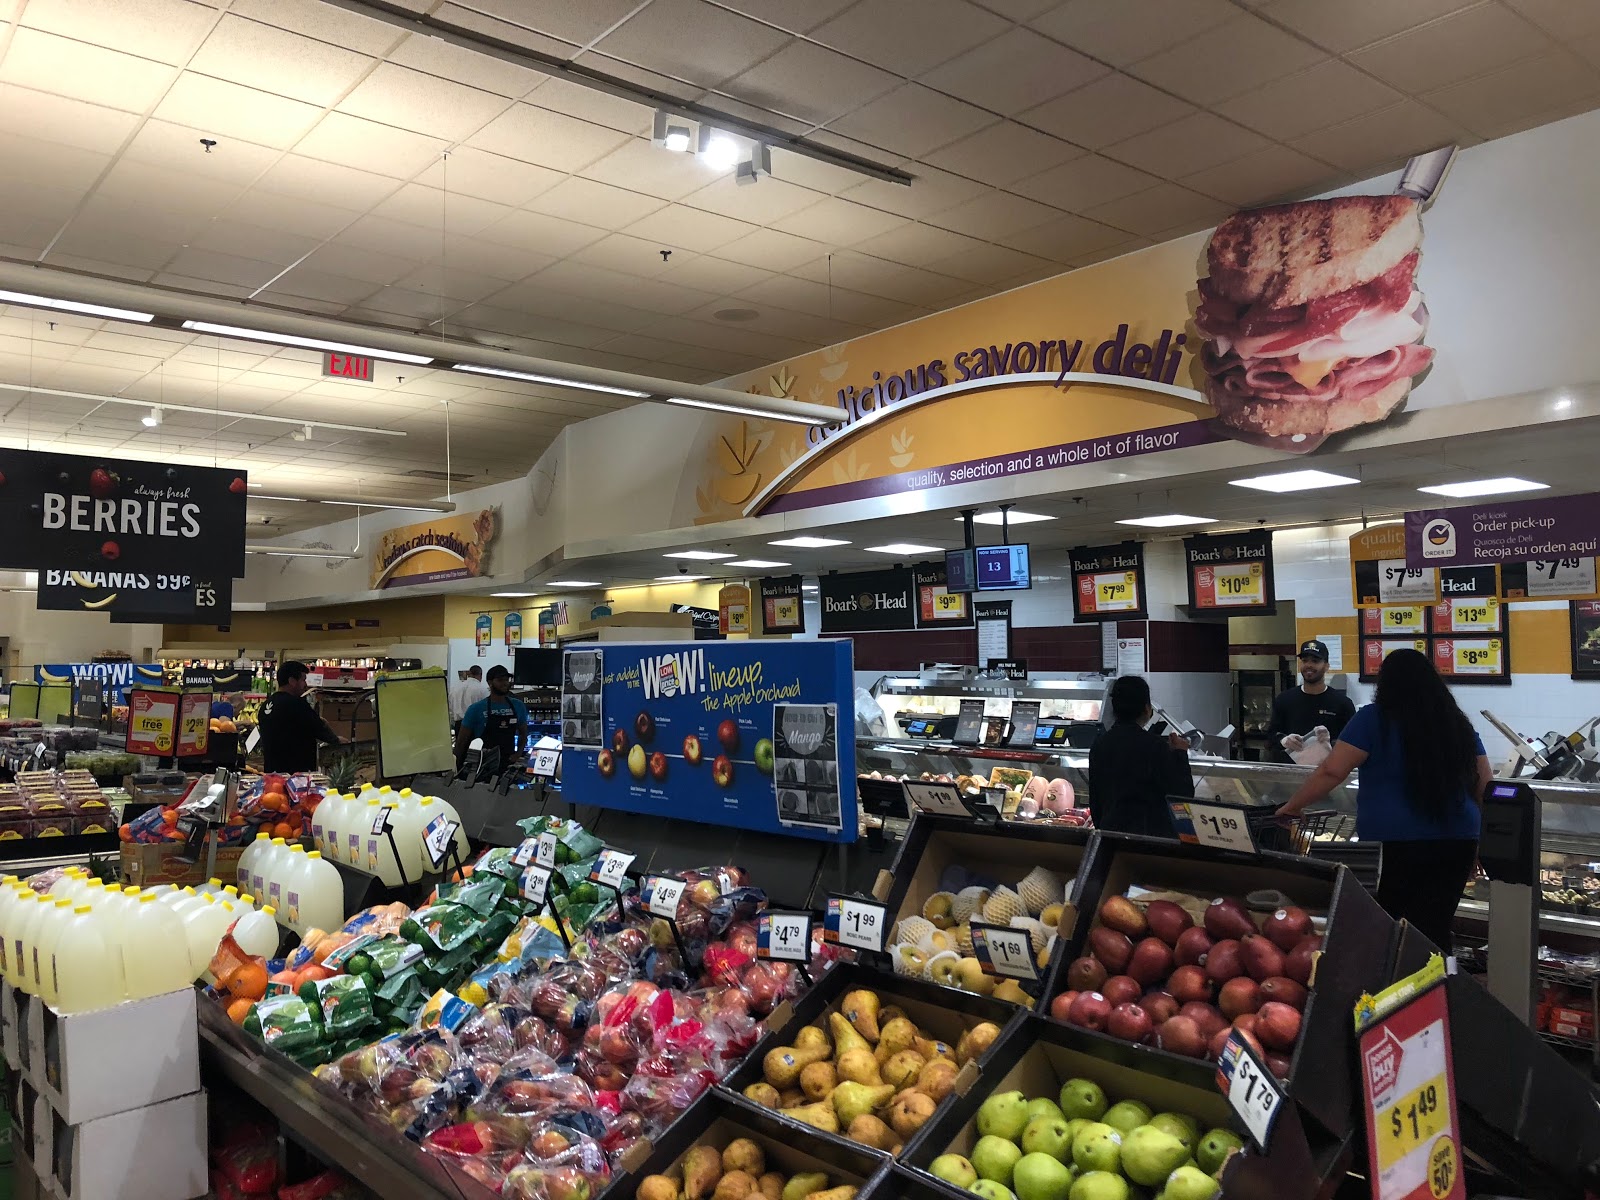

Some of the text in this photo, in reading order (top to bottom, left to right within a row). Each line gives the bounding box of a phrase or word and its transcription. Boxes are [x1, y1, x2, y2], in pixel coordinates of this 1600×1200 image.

[954, 338, 1083, 388] savory
[1092, 323, 1187, 385] deli
[907, 430, 1180, 489] quality, selection and a whole lot of flavor
[134, 484, 191, 501] always fresh
[43, 492, 201, 538] BERRIES
[1473, 516, 1555, 533] Order pick-up
[1518, 534, 1533, 543] Deli
[1190, 544, 1266, 561] Boar's Head
[1474, 537, 1597, 559] Recoja su orden aquí
[952, 565, 960, 574] 13
[987, 561, 1001, 572] 13
[1074, 554, 1138, 571] Boar's Head
[918, 572, 937, 583] Boar's
[1441, 577, 1476, 593] Head
[196, 588, 216, 607] ES
[784, 585, 799, 594] Head
[825, 590, 907, 612] Boar's Head
[72, 663, 134, 687] WOW!
[616, 665, 640, 683] added
[660, 663, 674, 677] LOW
[708, 661, 763, 697] lineup,
[1010, 668, 1024, 678] Head
[185, 676, 213, 684] BANANAS
[626, 681, 633, 689] TO
[523, 696, 562, 704] Boar's He
[700, 694, 720, 712] The
[723, 687, 753, 714] Apple
[142, 718, 163, 729] free
[788, 729, 821, 750] Mango
[1199, 814, 1238, 835] $199
[656, 886, 677, 904] $499
[846, 911, 875, 932] $199
[775, 925, 800, 945] $479
[992, 940, 1021, 961] $169
[1239, 1060, 1274, 1111] $179
[1391, 1084, 1437, 1140] $149
